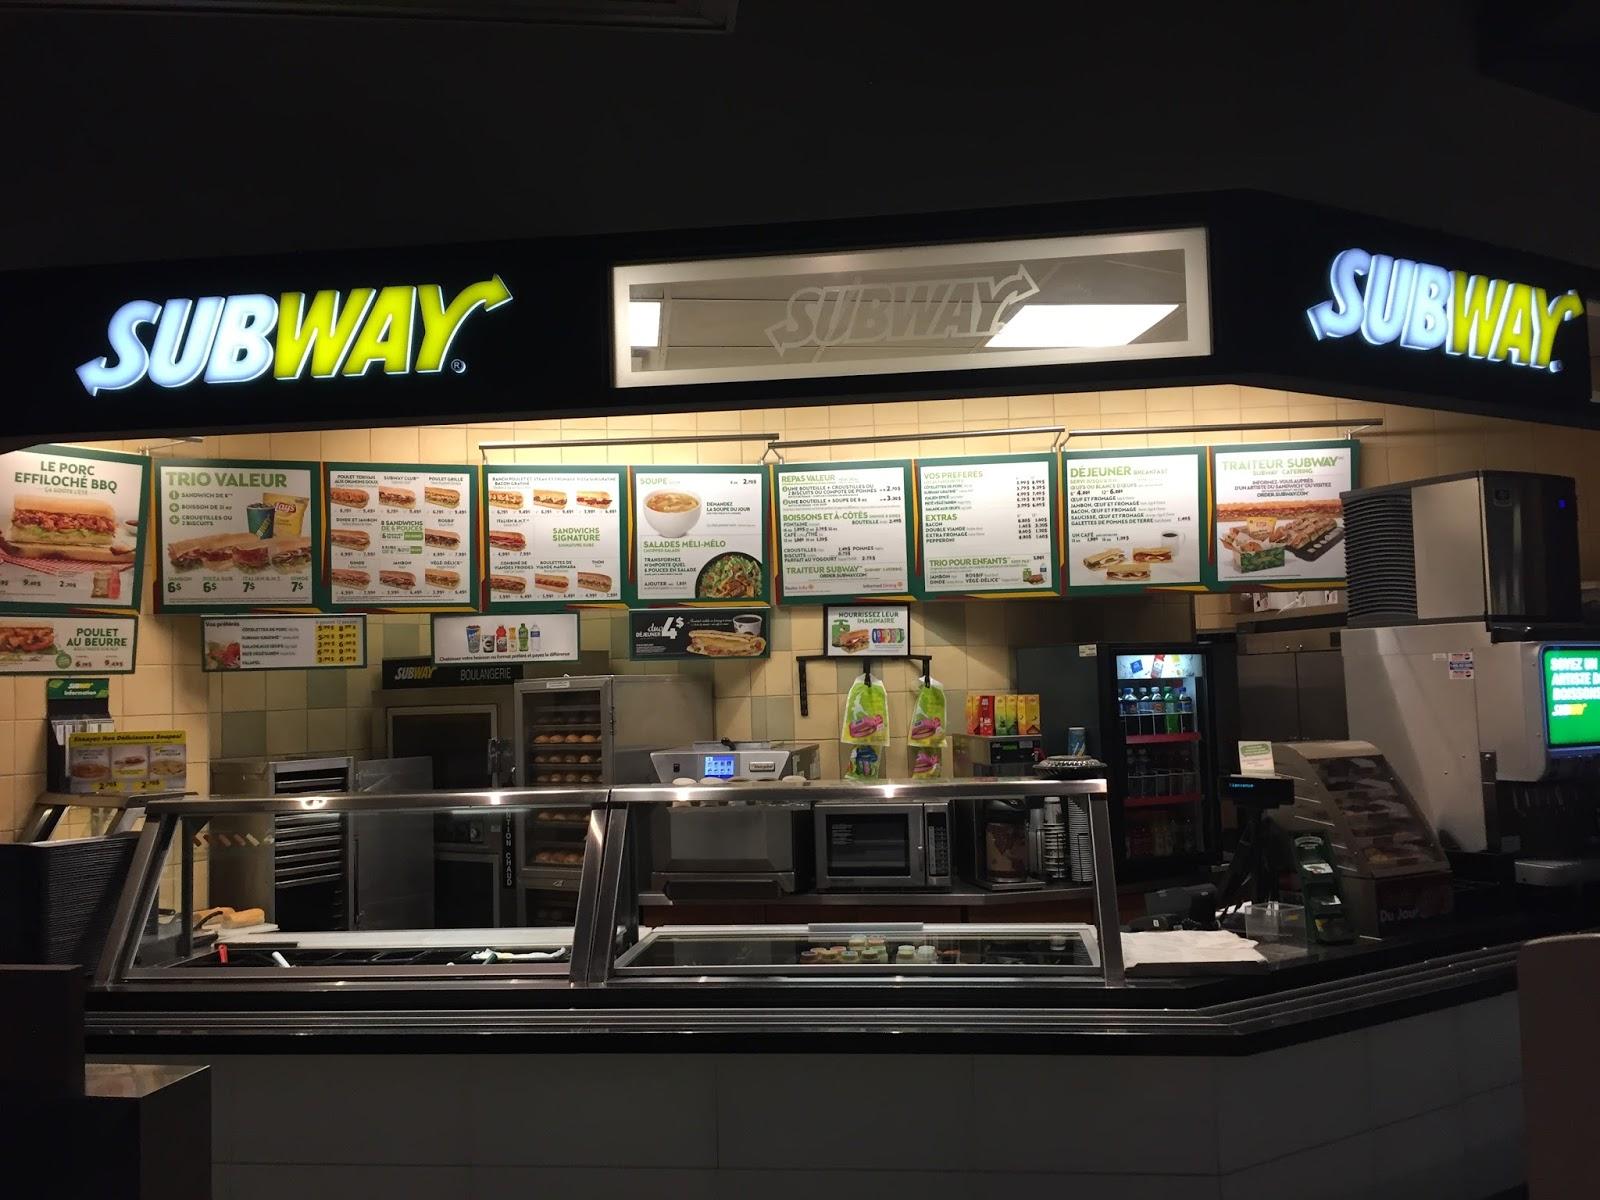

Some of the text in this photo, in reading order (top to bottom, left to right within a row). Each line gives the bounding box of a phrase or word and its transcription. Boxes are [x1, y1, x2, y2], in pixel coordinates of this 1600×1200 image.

[764, 264, 1040, 357] SUBWAY
[1307, 248, 1585, 369] SUBWAY
[76, 273, 513, 396] SUBWAY
[40, 461, 95, 475] LE PORC
[1221, 456, 1338, 471] TRAITEUR SUBWAY
[1070, 466, 1131, 477] DÉJEUNER
[15, 472, 118, 494] EFFILOCHÉ BBQ
[166, 472, 287, 488] TRIO VALEUR
[640, 477, 668, 485] SOUPE
[781, 475, 806, 483] REPAS
[806, 474, 836, 482] VALEUR
[682, 539, 726, 548] MÉLI-MÉLO
[930, 559, 948, 567] TRIO
[972, 557, 1008, 565] ENFANTS
[786, 567, 825, 575] TRAITEUR
[167, 582, 182, 593] 6$
[203, 582, 217, 593] 6$
[242, 582, 255, 592] 7$
[291, 582, 304, 592] 7$
[76, 628, 119, 637] POULET
[648, 623, 662, 632] duo
[661, 616, 685, 640] 4$
[66, 638, 128, 647] AU BEURRE
[395, 666, 512, 681] SUBWAY BOULANGERIE
[505, 852, 513, 887] CHAUD
